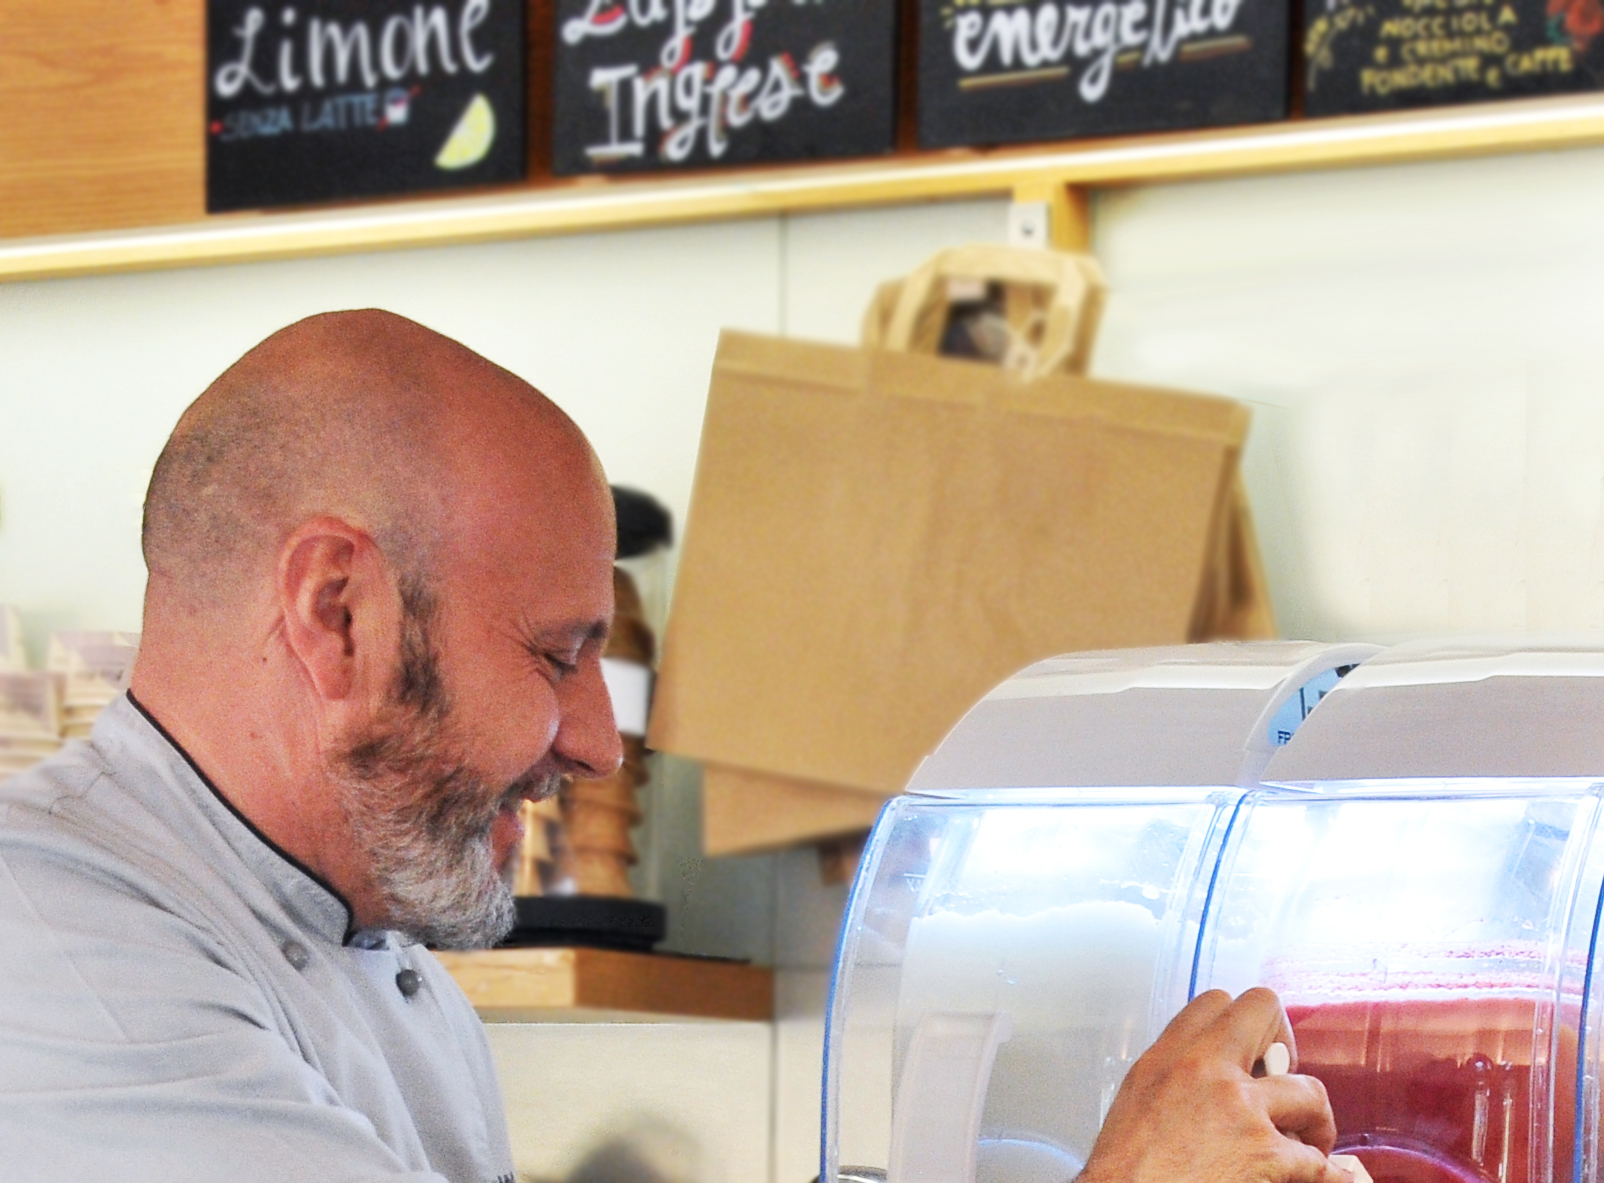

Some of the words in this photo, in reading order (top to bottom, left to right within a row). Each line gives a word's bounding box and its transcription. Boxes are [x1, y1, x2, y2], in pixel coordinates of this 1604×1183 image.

[214, 0, 494, 97] Limone
[220, 106, 293, 142] SENZA
[302, 93, 379, 132] LATTE
